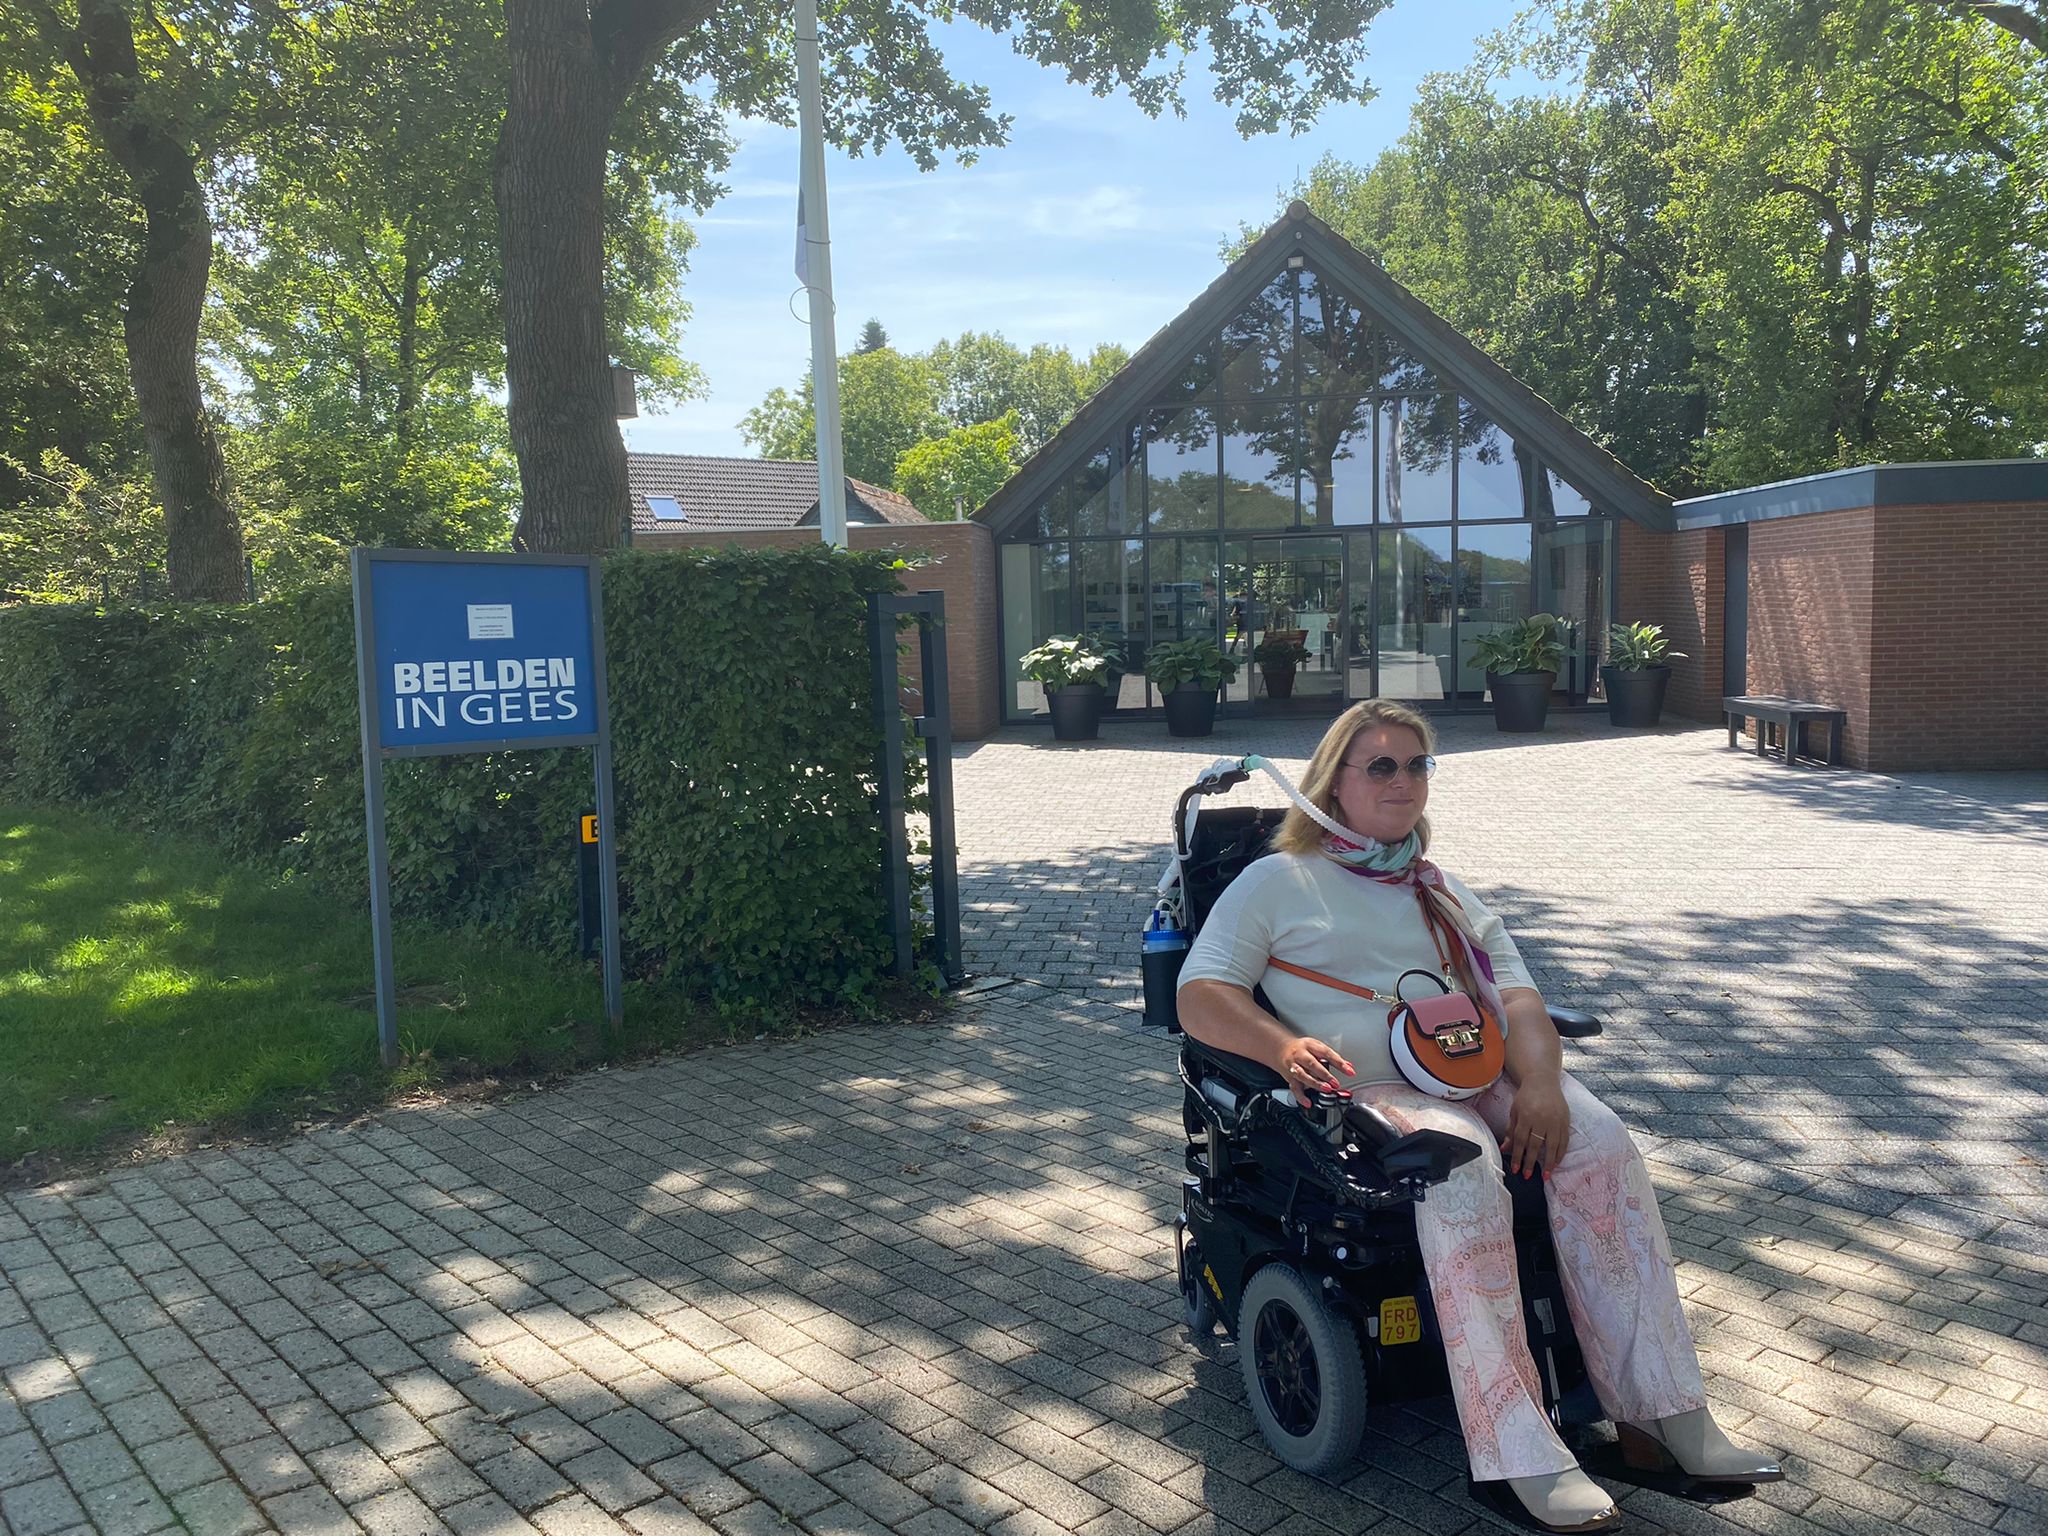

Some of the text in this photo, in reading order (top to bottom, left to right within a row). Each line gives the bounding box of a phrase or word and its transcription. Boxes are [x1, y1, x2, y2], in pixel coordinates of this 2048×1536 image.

[394, 657, 576, 694] BEELDEN
[396, 690, 578, 729] IN GEES
[1384, 1307, 1417, 1325] FRD
[1385, 1324, 1417, 1341] 797
